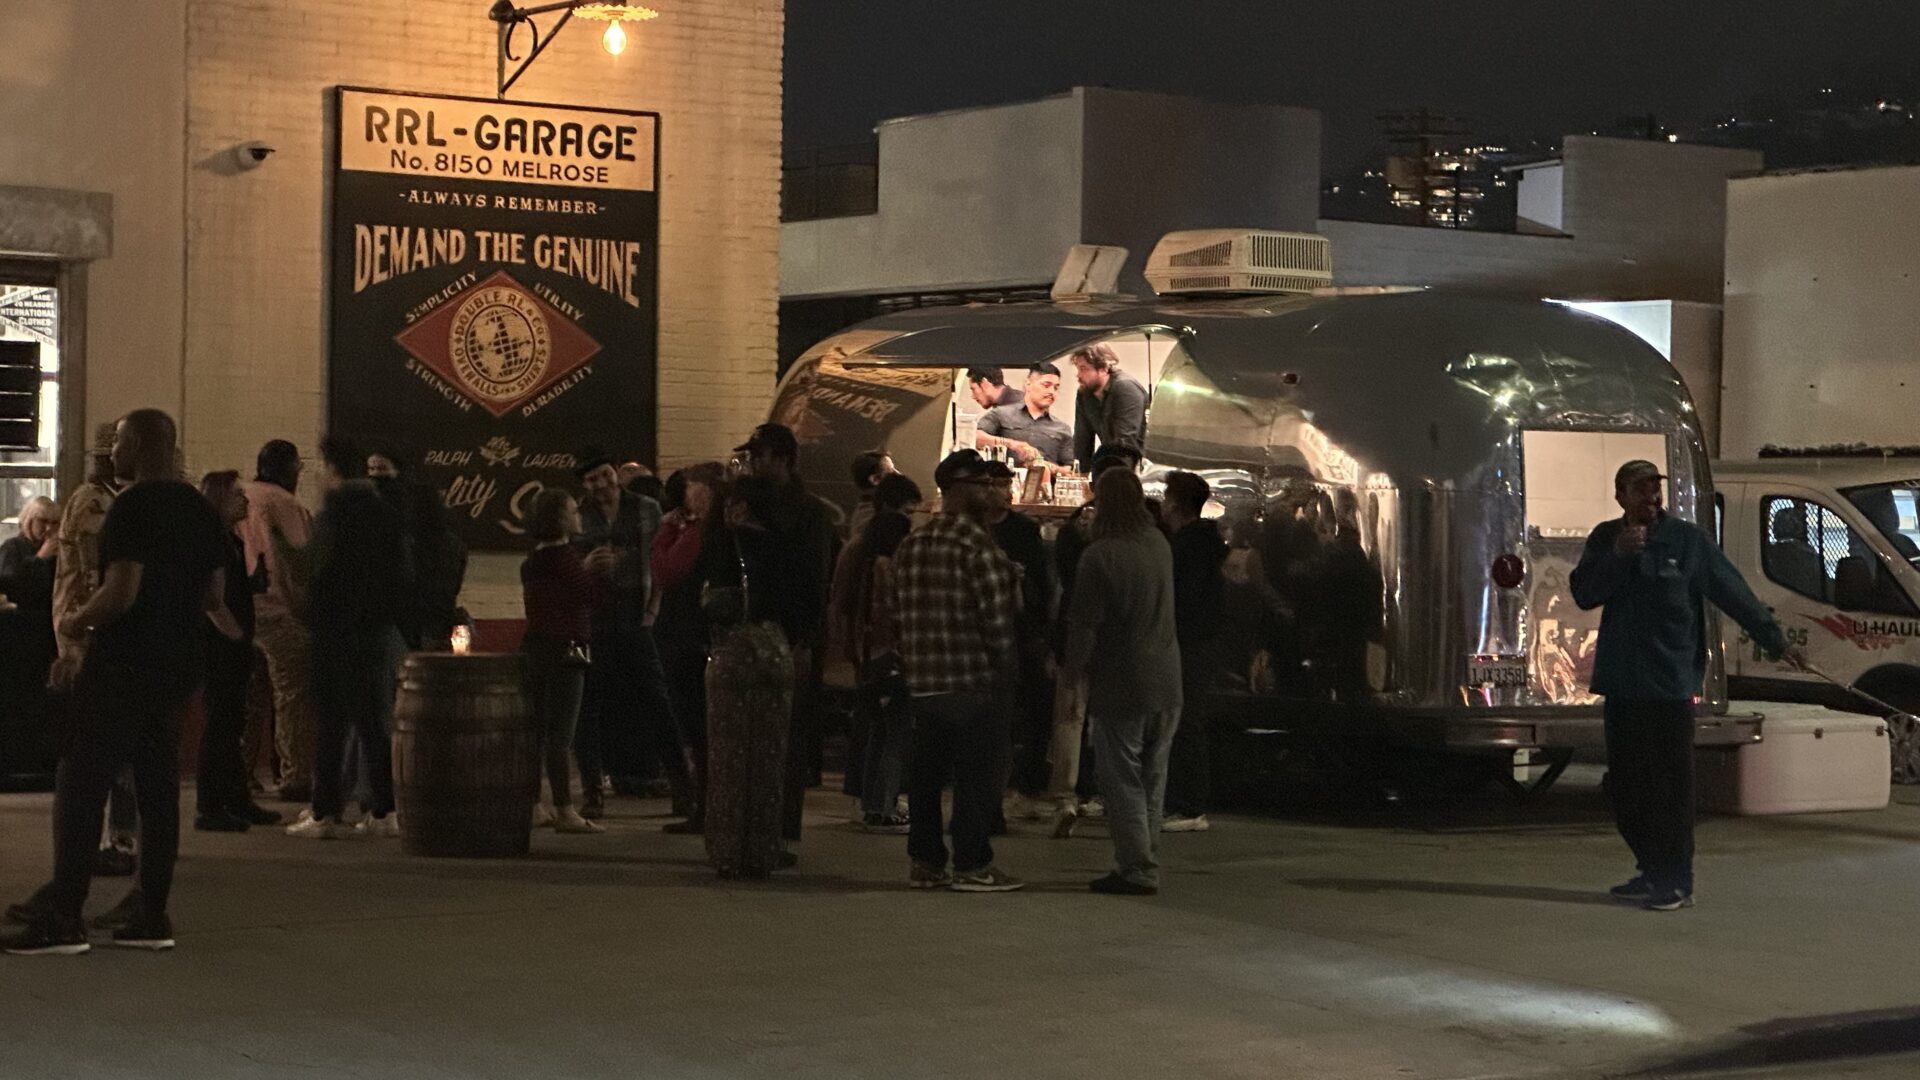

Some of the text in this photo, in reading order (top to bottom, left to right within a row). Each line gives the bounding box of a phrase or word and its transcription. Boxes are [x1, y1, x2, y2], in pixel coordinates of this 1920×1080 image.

[364, 104, 638, 162] RRL-GARAGE
[390, 149, 609, 183] No. 8150 MELROSE
[354, 223, 641, 308] DEMAND THE GENUINE
[404, 270, 478, 323] SIMPLICITY
[454, 290, 502, 337] DOUBLE
[507, 293, 527, 310] RL
[533, 282, 584, 321] UTILITY
[404, 358, 473, 412] STRENGTH
[454, 347, 499, 397] OVERALLS
[522, 364, 595, 418] DURABILITY
[424, 450, 578, 469] RALPH LAUREN
